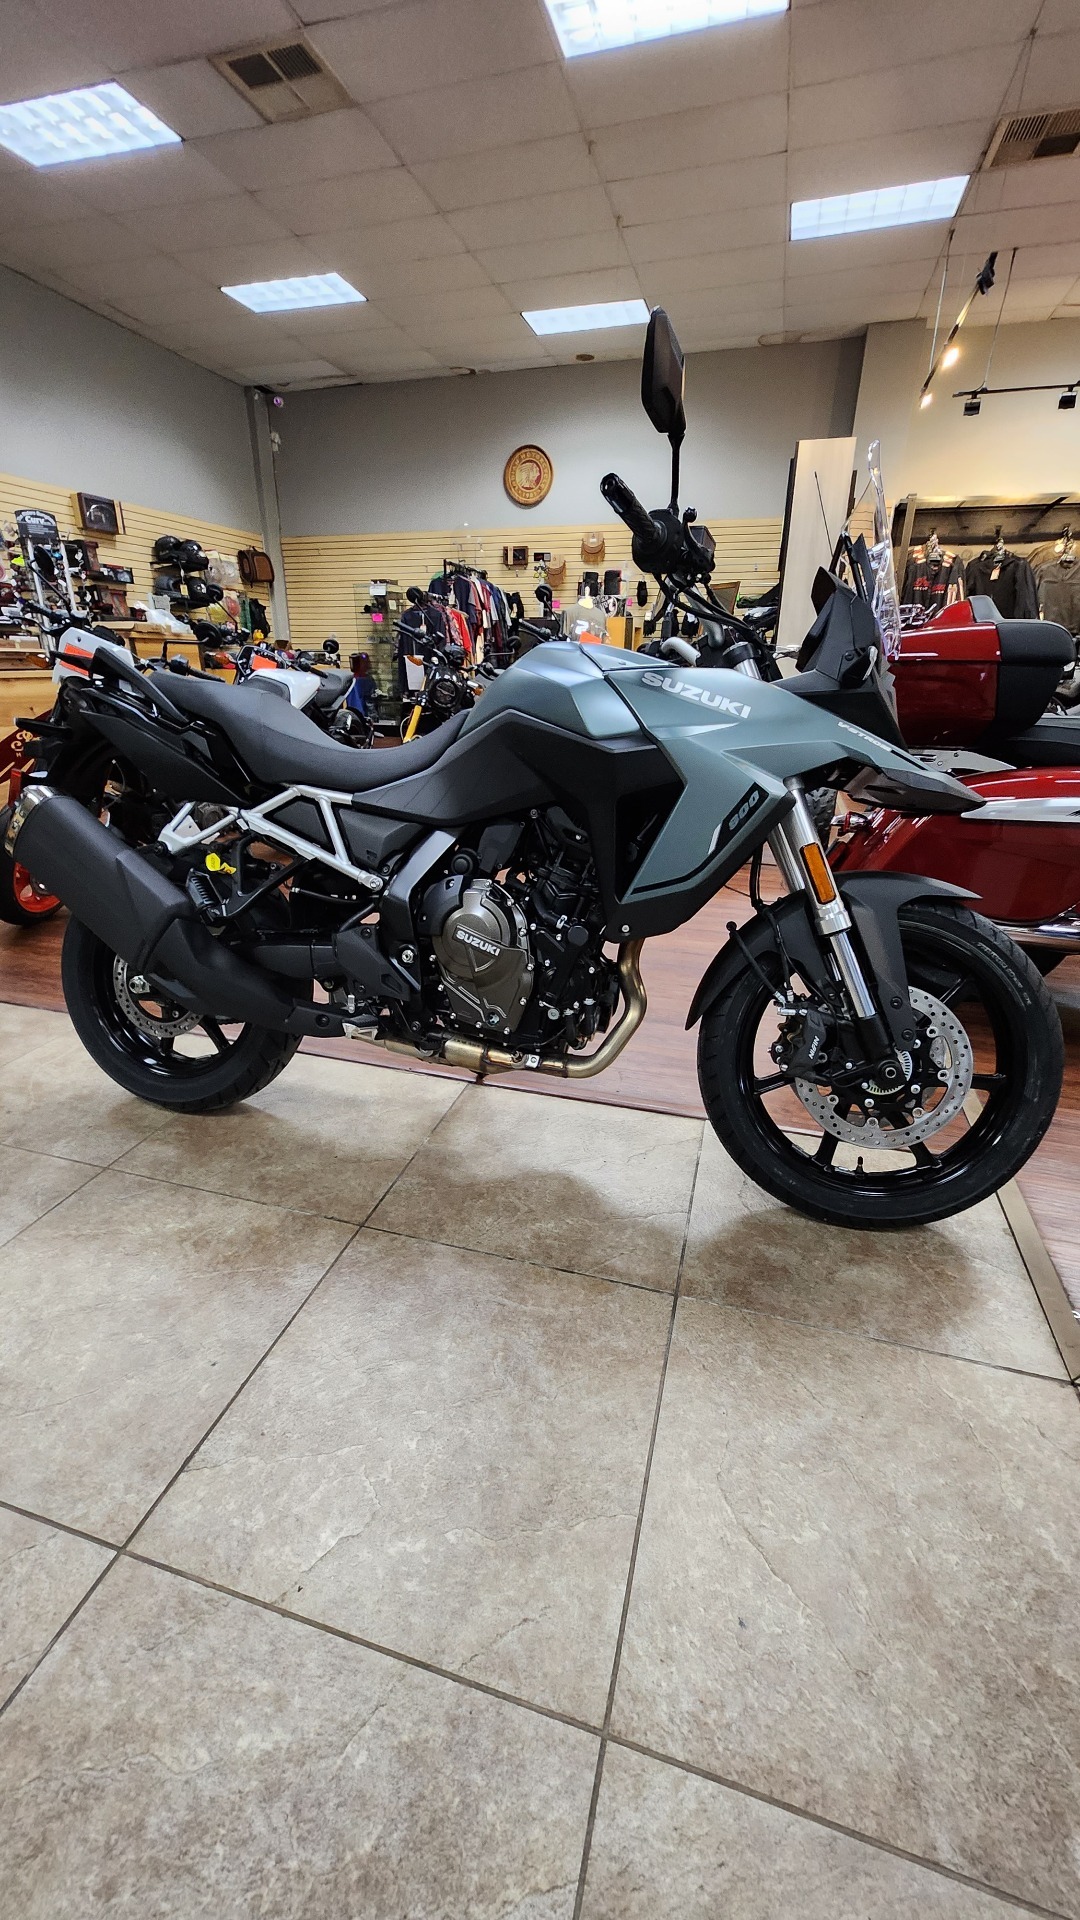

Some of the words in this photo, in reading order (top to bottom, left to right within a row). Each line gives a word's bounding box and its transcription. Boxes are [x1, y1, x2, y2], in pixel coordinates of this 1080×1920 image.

[641, 672, 752, 719] SUZUKI
[728, 790, 760, 831] 800
[456, 930, 501, 957] SUZUKI
